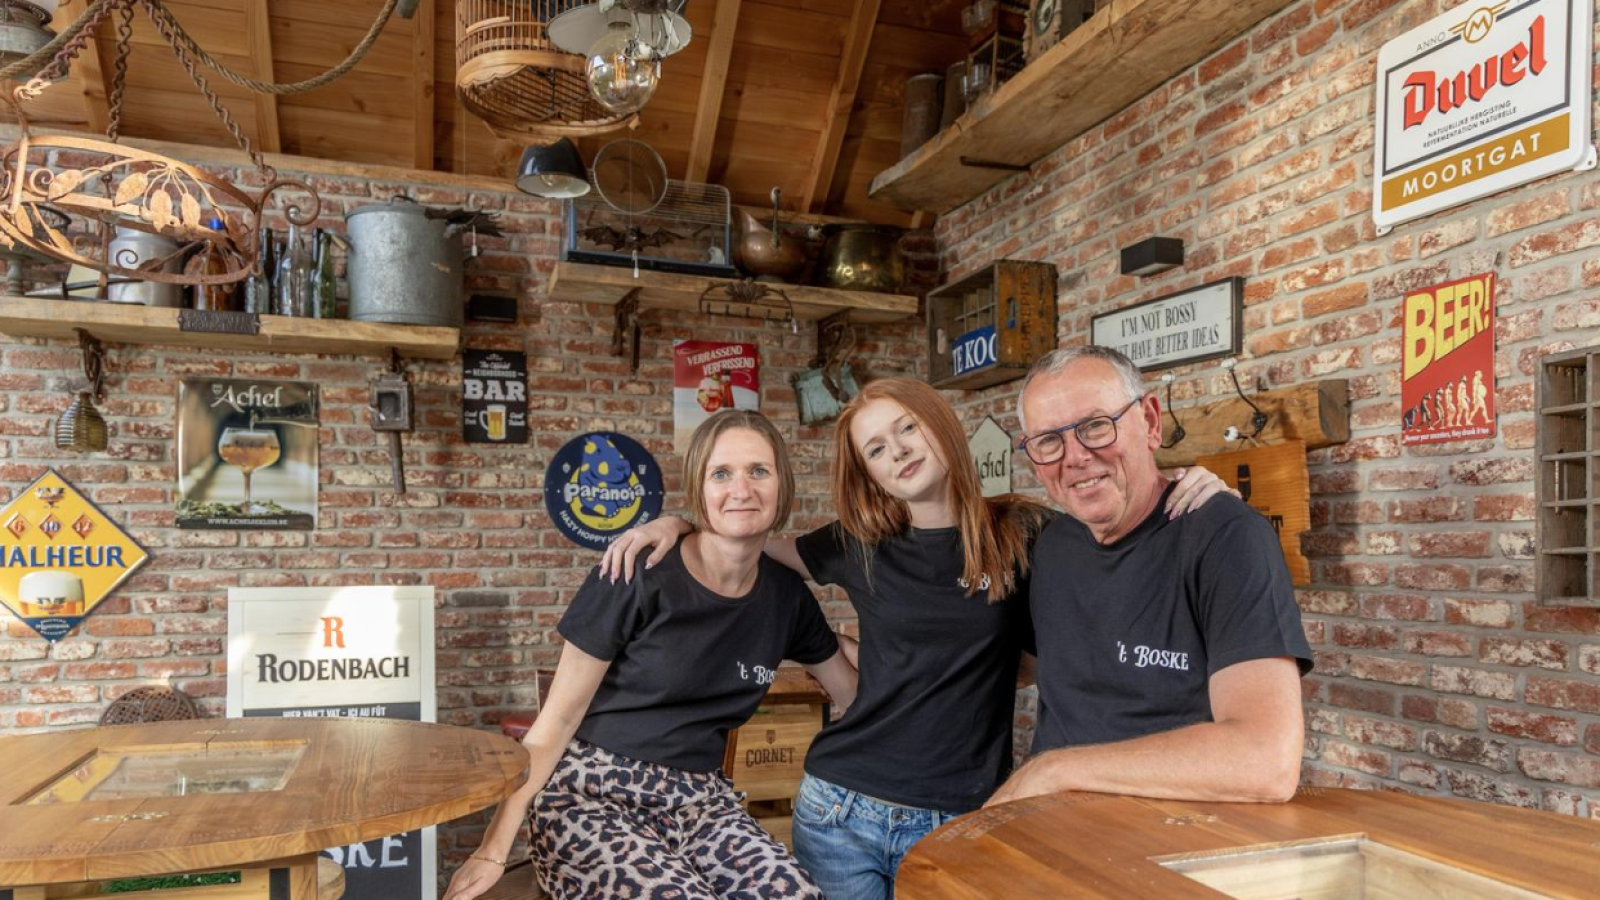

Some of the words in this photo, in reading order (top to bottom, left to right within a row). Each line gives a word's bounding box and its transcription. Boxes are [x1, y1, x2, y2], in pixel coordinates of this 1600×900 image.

[1416, 31, 1447, 52] ANNO
[1402, 14, 1548, 131] Duvel
[1423, 123, 1478, 148] REFERMENTATION
[1480, 107, 1517, 126] NATURELLE
[1428, 117, 1469, 138] NATUURLIJKE
[1470, 100, 1511, 121] HERGISTING
[1402, 133, 1541, 198] MOORTGAT
[1121, 316, 1138, 338] I'M
[1141, 309, 1162, 333] NOT
[1165, 301, 1198, 327] BOSSY
[1403, 277, 1491, 382] BEER!
[686, 345, 743, 366] VERRASSEND
[1131, 338, 1152, 360] HAVE
[1155, 331, 1189, 356] BETTER
[1192, 323, 1220, 348] IDEAS
[703, 357, 756, 376] VERFRISSEND
[210, 384, 284, 413] Achel
[463, 379, 526, 402] BAR
[560, 510, 579, 532] HAZY
[577, 528, 607, 543] HOPPY
[321, 616, 346, 649] R
[255, 653, 411, 684] RODENBACH
[1133, 645, 1189, 671] BOSKE
[746, 747, 796, 768] CORNET
